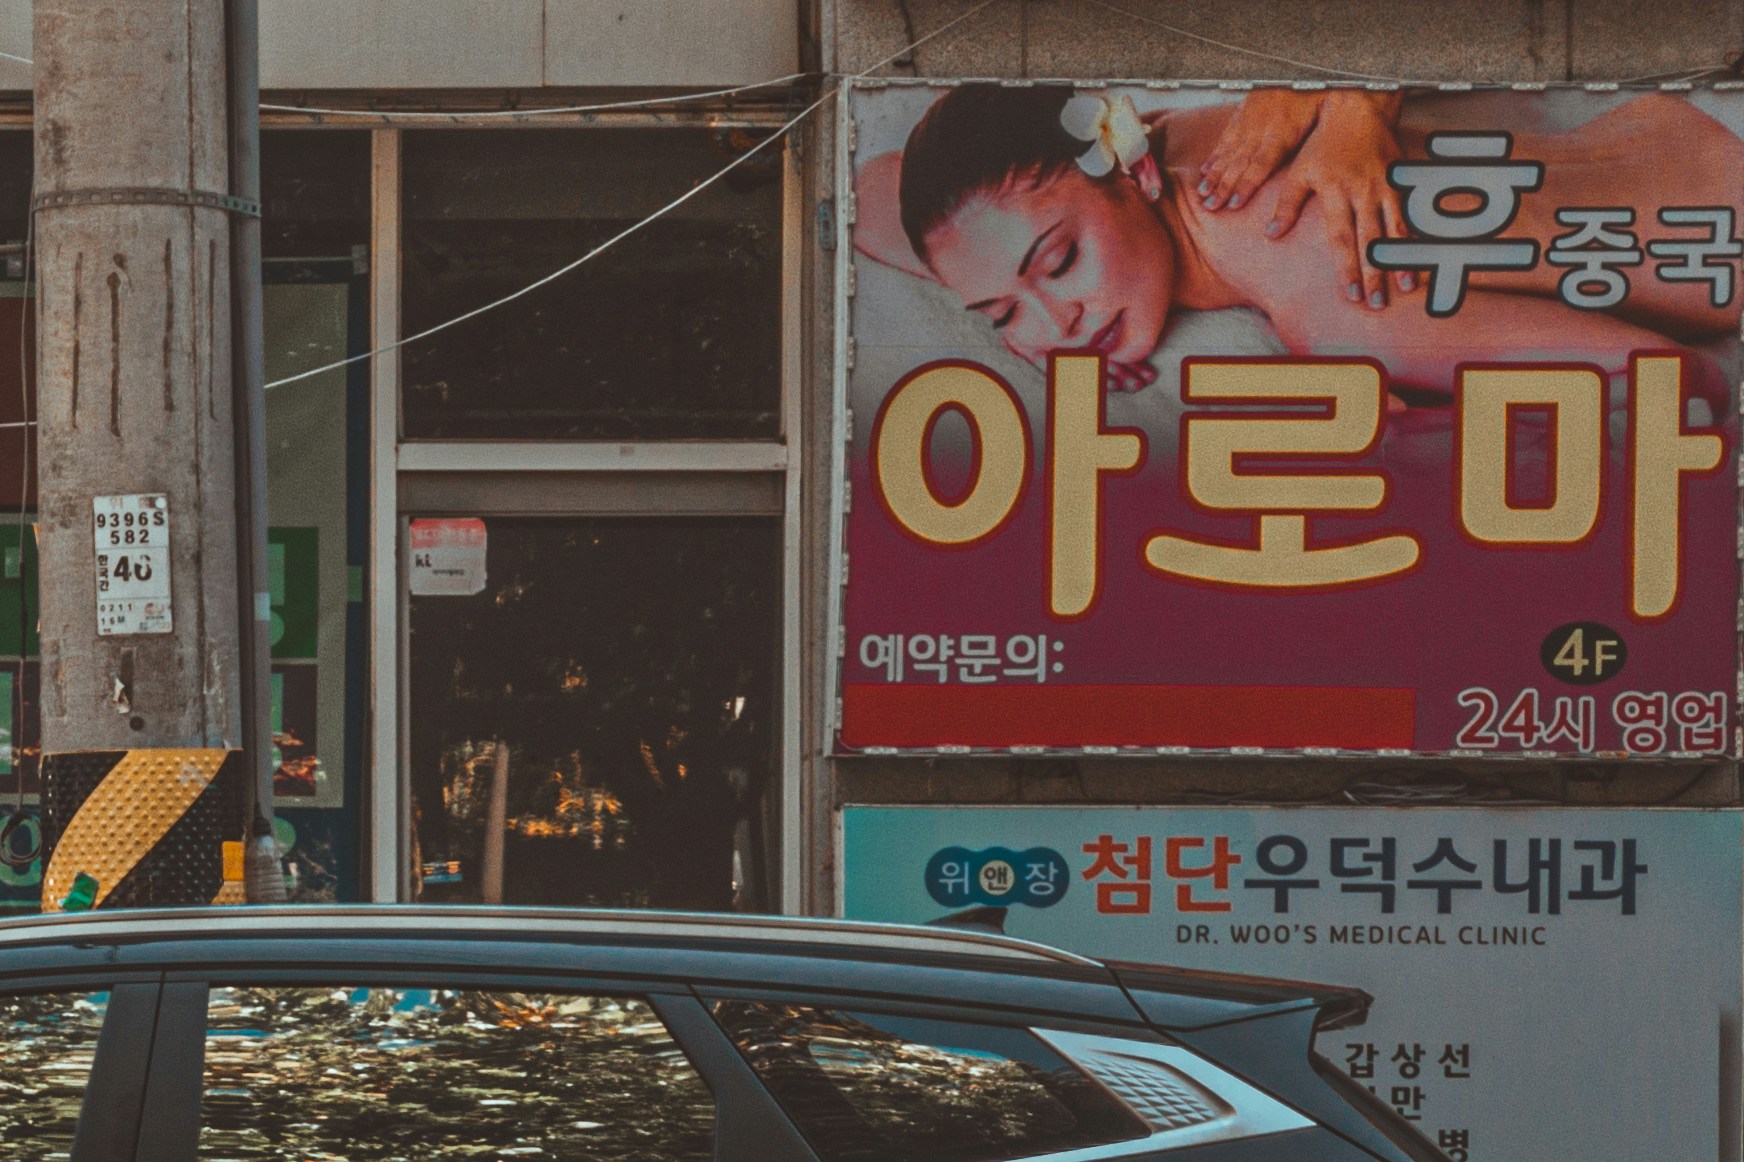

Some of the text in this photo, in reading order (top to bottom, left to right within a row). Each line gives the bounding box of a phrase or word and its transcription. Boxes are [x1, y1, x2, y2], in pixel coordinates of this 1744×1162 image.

[1366, 130, 1743, 318] 후 중국
[870, 349, 1728, 620] 아로마
[96, 511, 165, 529] 9396S
[110, 529, 150, 545] 582
[859, 634, 1064, 682] 예약문의:
[1553, 628, 1618, 676] 4F
[1456, 687, 1728, 754] 24시 영업
[1080, 834, 1649, 915] 첨단우덕수내과
[1176, 924, 1547, 945] DR. WOO'S MEDICAL CLINIC
[1371, 1086, 1426, 1121] 만
